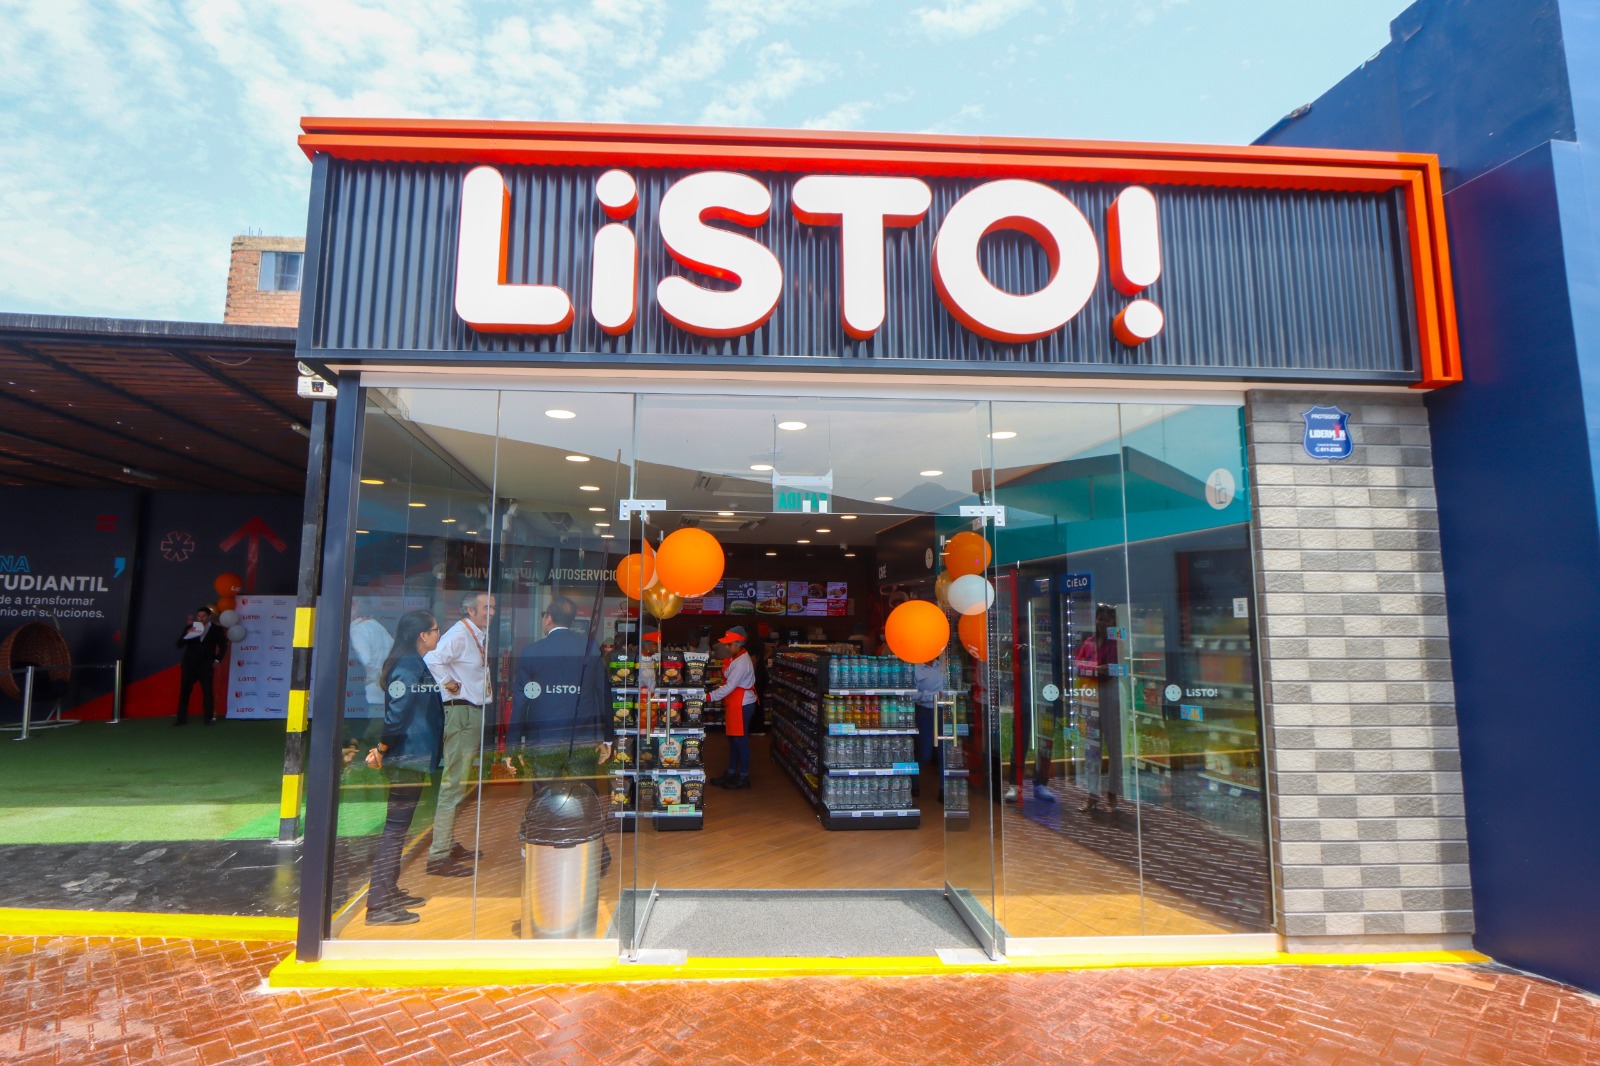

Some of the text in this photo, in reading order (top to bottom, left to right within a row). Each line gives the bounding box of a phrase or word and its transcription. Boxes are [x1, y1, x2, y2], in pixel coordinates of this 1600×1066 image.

[455, 165, 1164, 346] LiSTO!
[1067, 577, 1088, 588] CIELO
[15, 597, 22, 605] a
[25, 596, 95, 606] transformar
[21, 609, 36, 617] en
[545, 685, 581, 694] LiSTO!
[1186, 688, 1218, 697] LiSTO!
